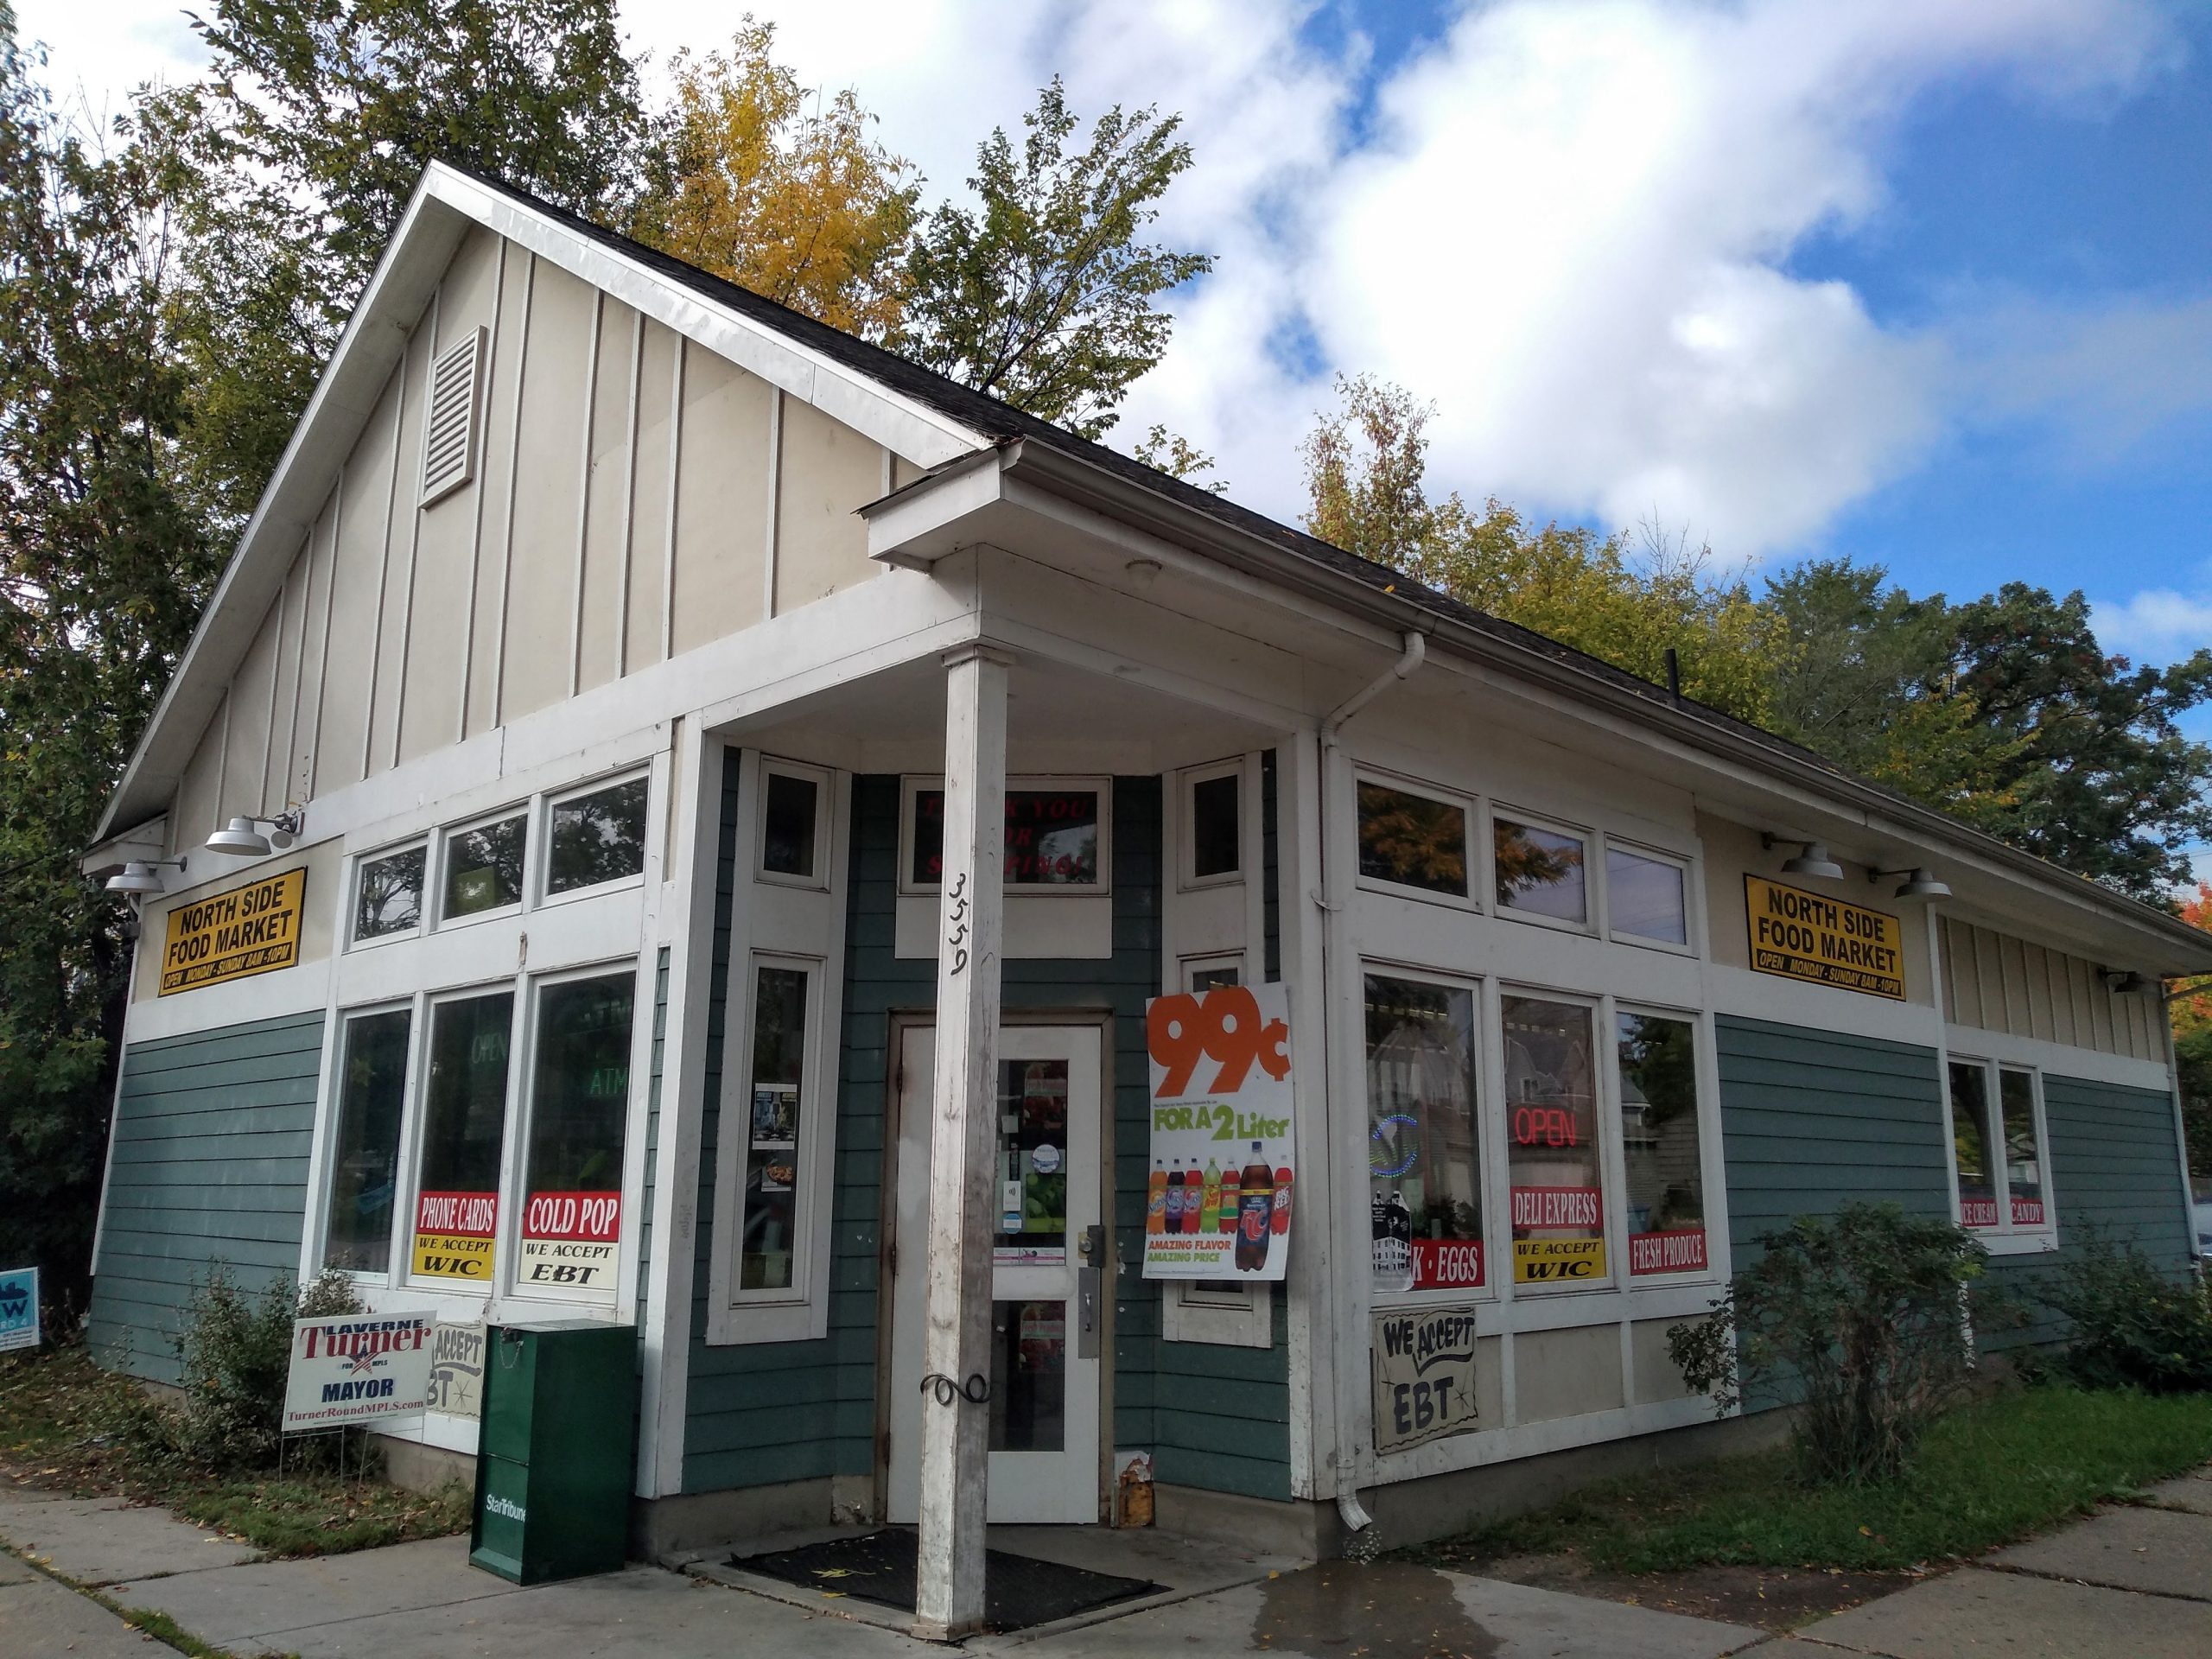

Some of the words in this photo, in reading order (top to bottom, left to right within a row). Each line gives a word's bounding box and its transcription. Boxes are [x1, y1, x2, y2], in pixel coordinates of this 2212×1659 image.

[1033, 798, 1086, 818] YOU
[180, 895, 238, 936] NORTH
[241, 880, 285, 918] SIDE
[1768, 887, 1838, 930] NORTH
[1843, 909, 1885, 943] SIDE
[168, 934, 211, 967] FOOD
[214, 909, 293, 955] MARKET
[949, 873, 968, 976] 3559
[1758, 916, 1815, 954] FOOD
[1820, 932, 1896, 974] MARKET
[165, 971, 183, 988] OPEN
[217, 956, 246, 976] SUNDAY
[1759, 952, 1783, 969] OPEN
[1790, 958, 1825, 979] MONDAY
[1828, 967, 1859, 986] SUNDAY
[1860, 974, 1877, 988] 8AM
[589, 1067, 629, 1095] ATM
[1154, 1106, 1193, 1132] FOR
[1195, 1105, 1212, 1130] A
[1211, 1103, 1235, 1141] 2
[1236, 1111, 1290, 1141] Liter
[1515, 1106, 1576, 1147] OPEN
[420, 1197, 456, 1230] PHONE
[457, 1197, 495, 1233] CARDS
[529, 1198, 576, 1234] COLD
[578, 1198, 619, 1236] POP
[1516, 1192, 1542, 1225] DELI
[1545, 1192, 1597, 1225] EXPRESS
[1973, 1202, 1997, 1224] CREAM
[2011, 1202, 2042, 1223] CANDY
[419, 1237, 438, 1249] WE
[440, 1238, 492, 1253] ACCEPT
[525, 1243, 549, 1255] WE
[551, 1244, 613, 1259] ACCEPT
[1147, 1240, 1192, 1251] AMAZING
[1195, 1239, 1231, 1251] FLAVOR
[1147, 1252, 1192, 1262] AMAZING
[1193, 1252, 1220, 1262] PRICE
[1517, 1243, 1539, 1255] WE
[1544, 1241, 1600, 1255] ACCEPT
[1633, 1236, 1662, 1270] FRESH
[1664, 1234, 1702, 1266] PRODUCE
[423, 1255, 482, 1275] WIC
[530, 1263, 600, 1285] EBT
[1436, 1246, 1478, 1282] EGGS
[1526, 1261, 1592, 1279] WIC
[21, 1318, 28, 1327] 4
[325, 1319, 424, 1336] LAVERNE
[300, 1326, 431, 1360] Turner
[435, 1329, 483, 1364] ACCEPT
[1383, 1319, 1414, 1357] WE
[1417, 1317, 1475, 1361] ACCEPT
[372, 1359, 388, 1368] MPLS
[321, 1378, 395, 1403] MAYOR
[427, 1370, 454, 1408] BT
[288, 1400, 423, 1422] TurnerRoundMPLS.com
[1394, 1376, 1454, 1435] EBT
